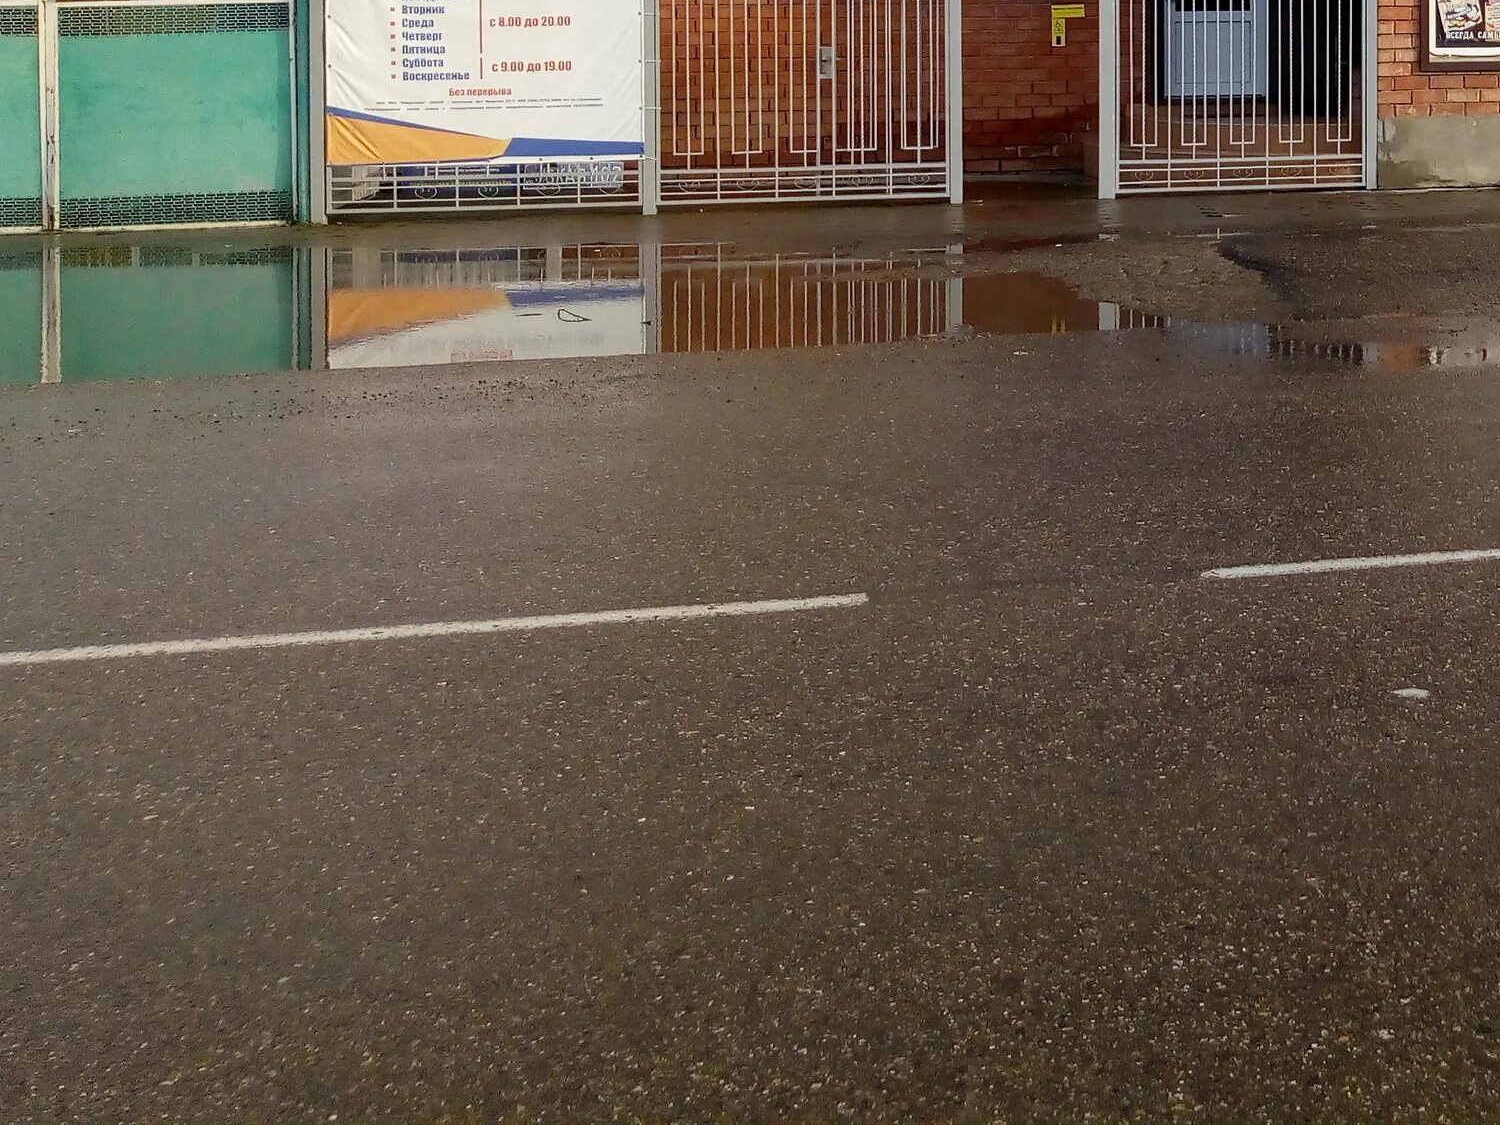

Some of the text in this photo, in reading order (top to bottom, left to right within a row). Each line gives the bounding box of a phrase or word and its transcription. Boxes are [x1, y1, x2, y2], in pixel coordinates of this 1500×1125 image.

[401, 4, 445, 16] Вторник
[401, 17, 434, 29] Среда
[489, 15, 571, 29] с 8.00 до 20.00
[401, 31, 443, 42] Четверг
[1446, 30, 1474, 40] ВСЕГДА
[401, 44, 446, 55] Пятница
[402, 58, 444, 69] Суббота
[491, 60, 572, 74] с 9.00 до 19.00
[402, 71, 470, 82] Воскресенье
[449, 87, 512, 97] Без перерыва
